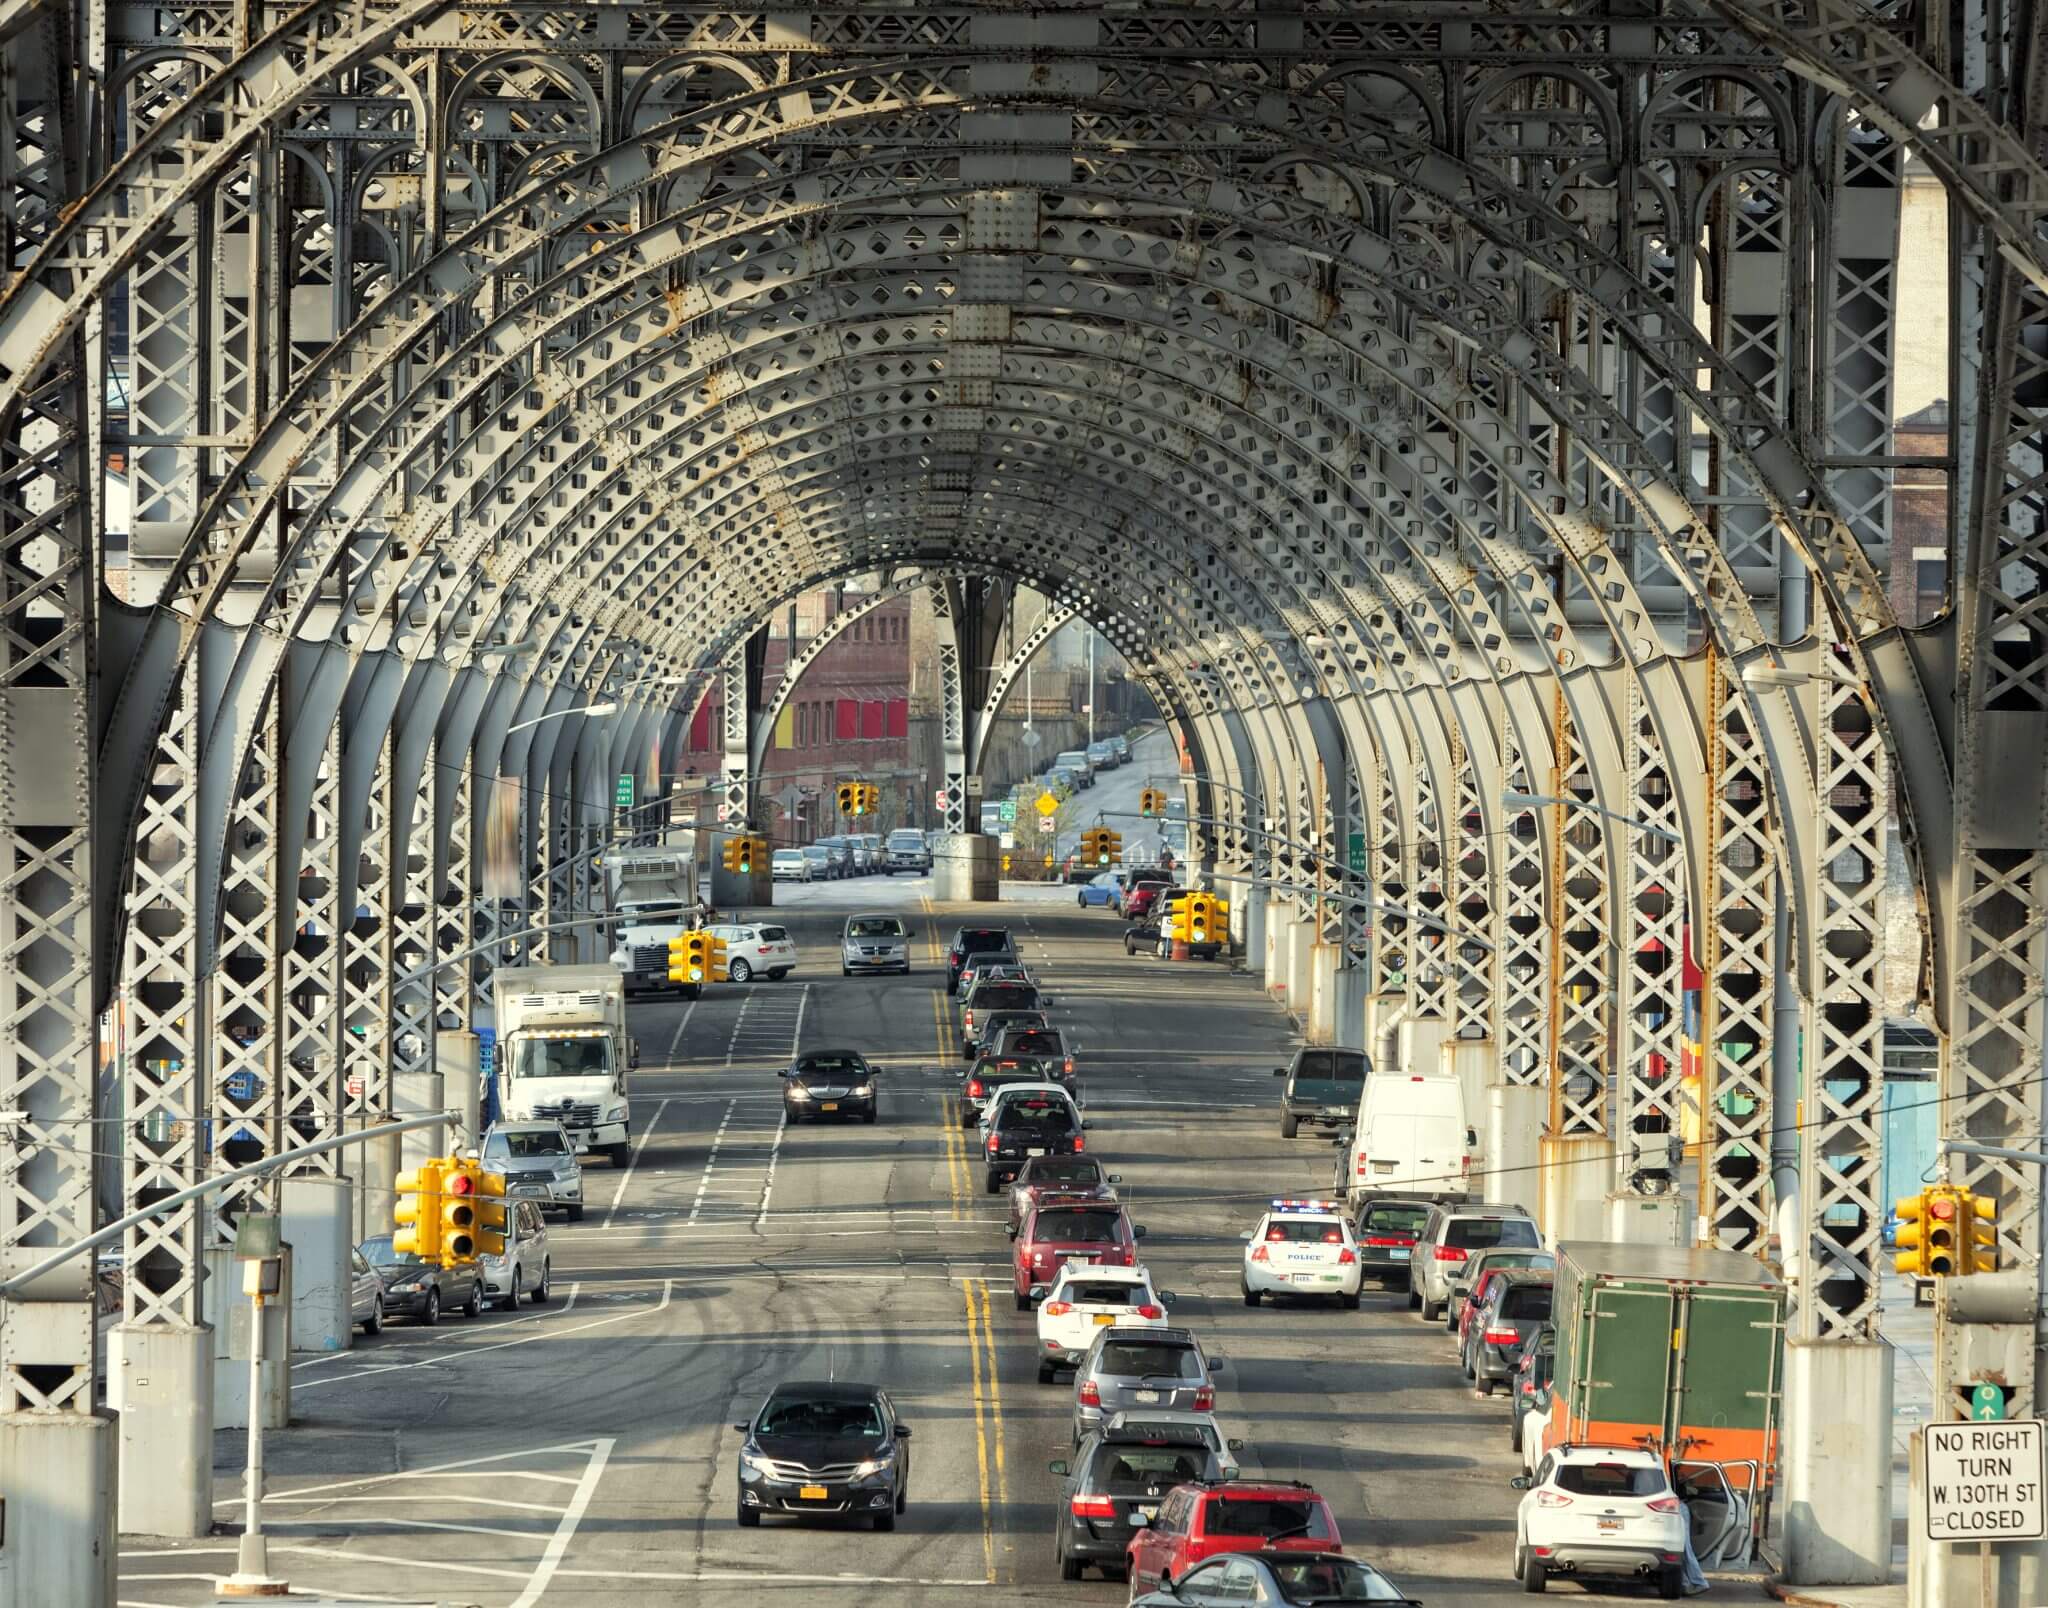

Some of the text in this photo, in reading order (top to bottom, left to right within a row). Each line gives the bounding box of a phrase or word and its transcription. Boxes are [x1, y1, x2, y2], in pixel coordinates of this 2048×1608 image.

[1936, 1431, 2031, 1451] NO RIGHT
[1957, 1458, 2011, 1477] TURN
[1933, 1483, 2036, 1504] W. 130TH ST
[1947, 1510, 2024, 1530] CLOSED
